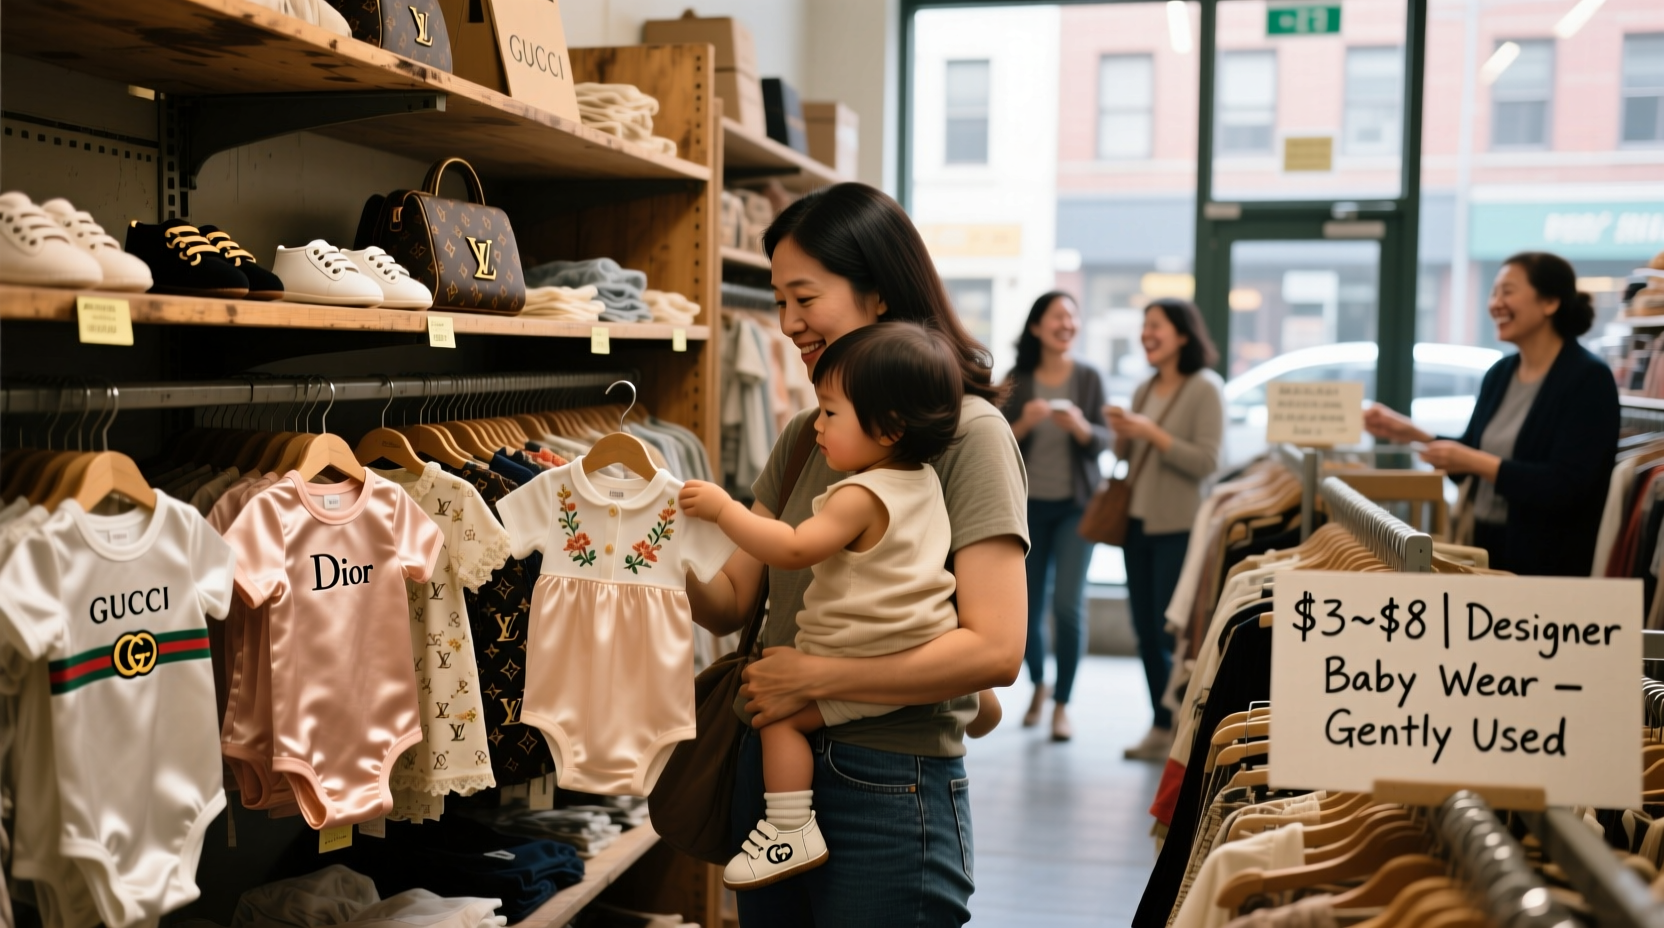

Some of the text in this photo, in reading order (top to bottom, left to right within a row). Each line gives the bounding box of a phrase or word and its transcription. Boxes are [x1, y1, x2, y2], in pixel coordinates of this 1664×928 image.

[509, 34, 564, 80] GUCCI
[310, 553, 374, 591] Dior
[89, 586, 169, 625] GUCCI
[1292, 591, 1427, 643] $3~$8
[1466, 602, 1622, 660] Designer
[1325, 655, 1417, 709] Baby
[1438, 661, 1539, 698] Wear
[1324, 707, 1567, 765] Gently Used
